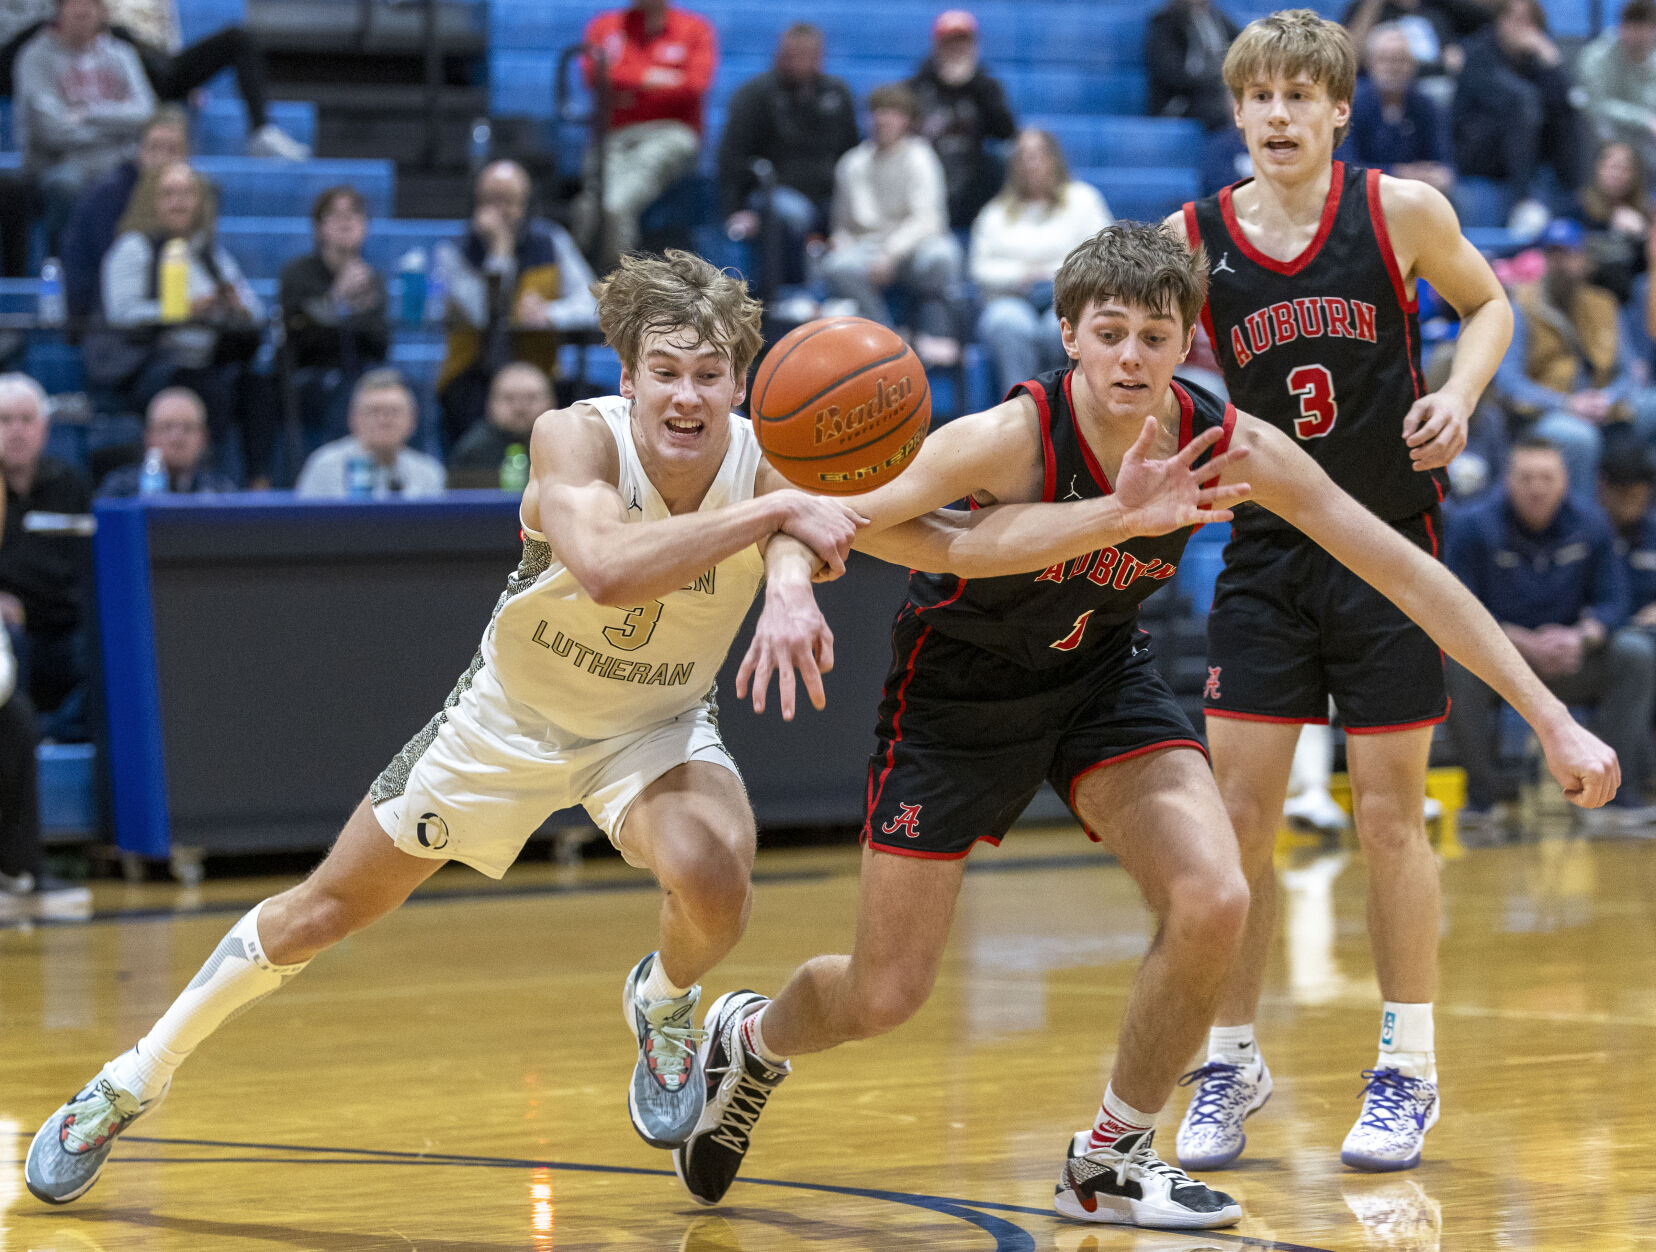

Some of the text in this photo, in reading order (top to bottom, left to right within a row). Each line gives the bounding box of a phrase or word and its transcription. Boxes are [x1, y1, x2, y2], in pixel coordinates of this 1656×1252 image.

[1231, 297, 1377, 368] AUBURN
[814, 375, 912, 446] Baden
[1286, 364, 1338, 440] 3
[531, 619, 695, 686] LUTHERAN
[602, 598, 664, 652] 3
[882, 801, 923, 838] A
